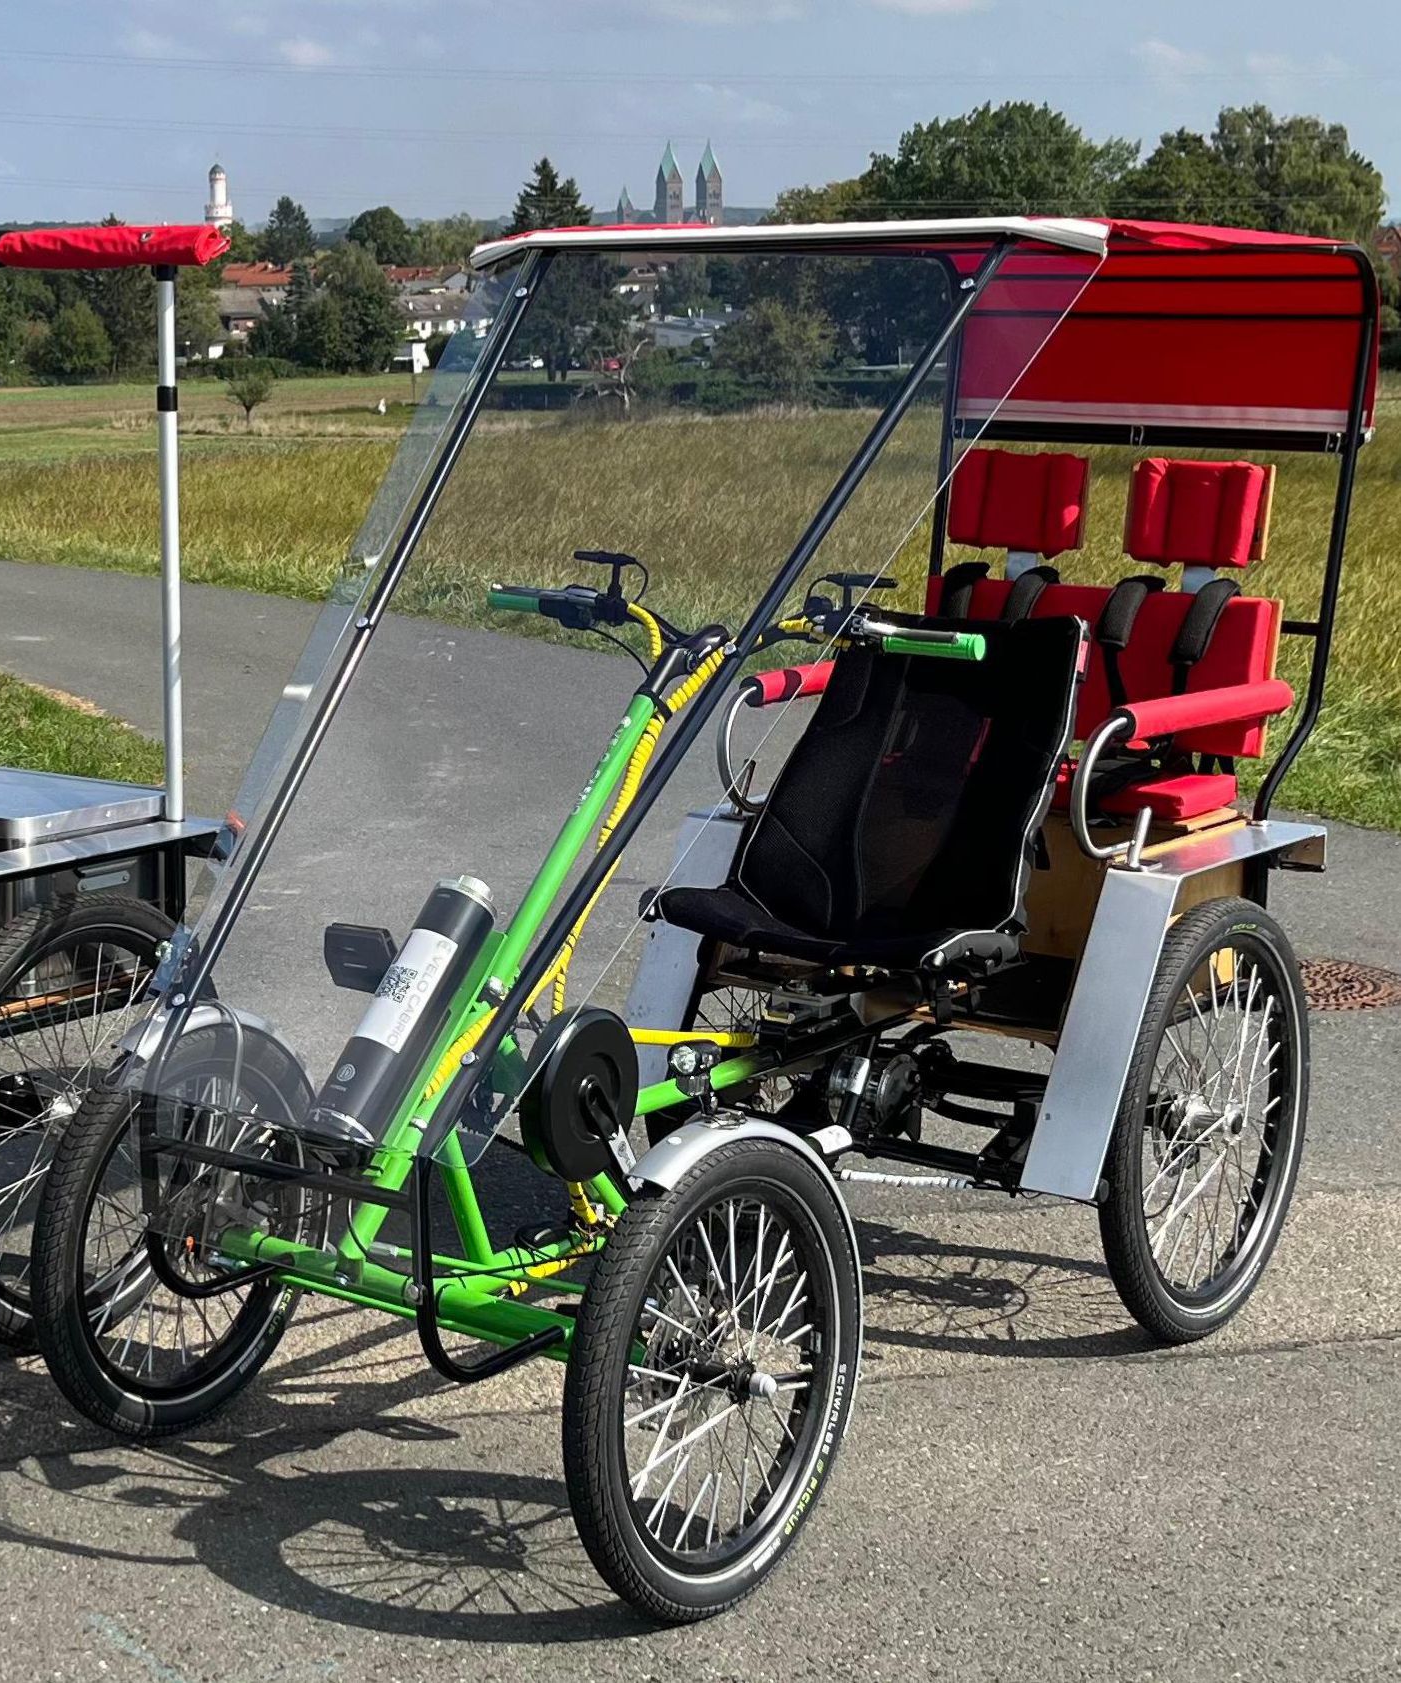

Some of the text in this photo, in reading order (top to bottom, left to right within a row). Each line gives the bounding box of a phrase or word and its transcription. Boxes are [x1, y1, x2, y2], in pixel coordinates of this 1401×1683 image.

[386, 956, 442, 1047] VELO CABRIO
[268, 1288, 295, 1336] ICK-UP
[784, 1362, 848, 1536] SCHWALBE PICK-UP
